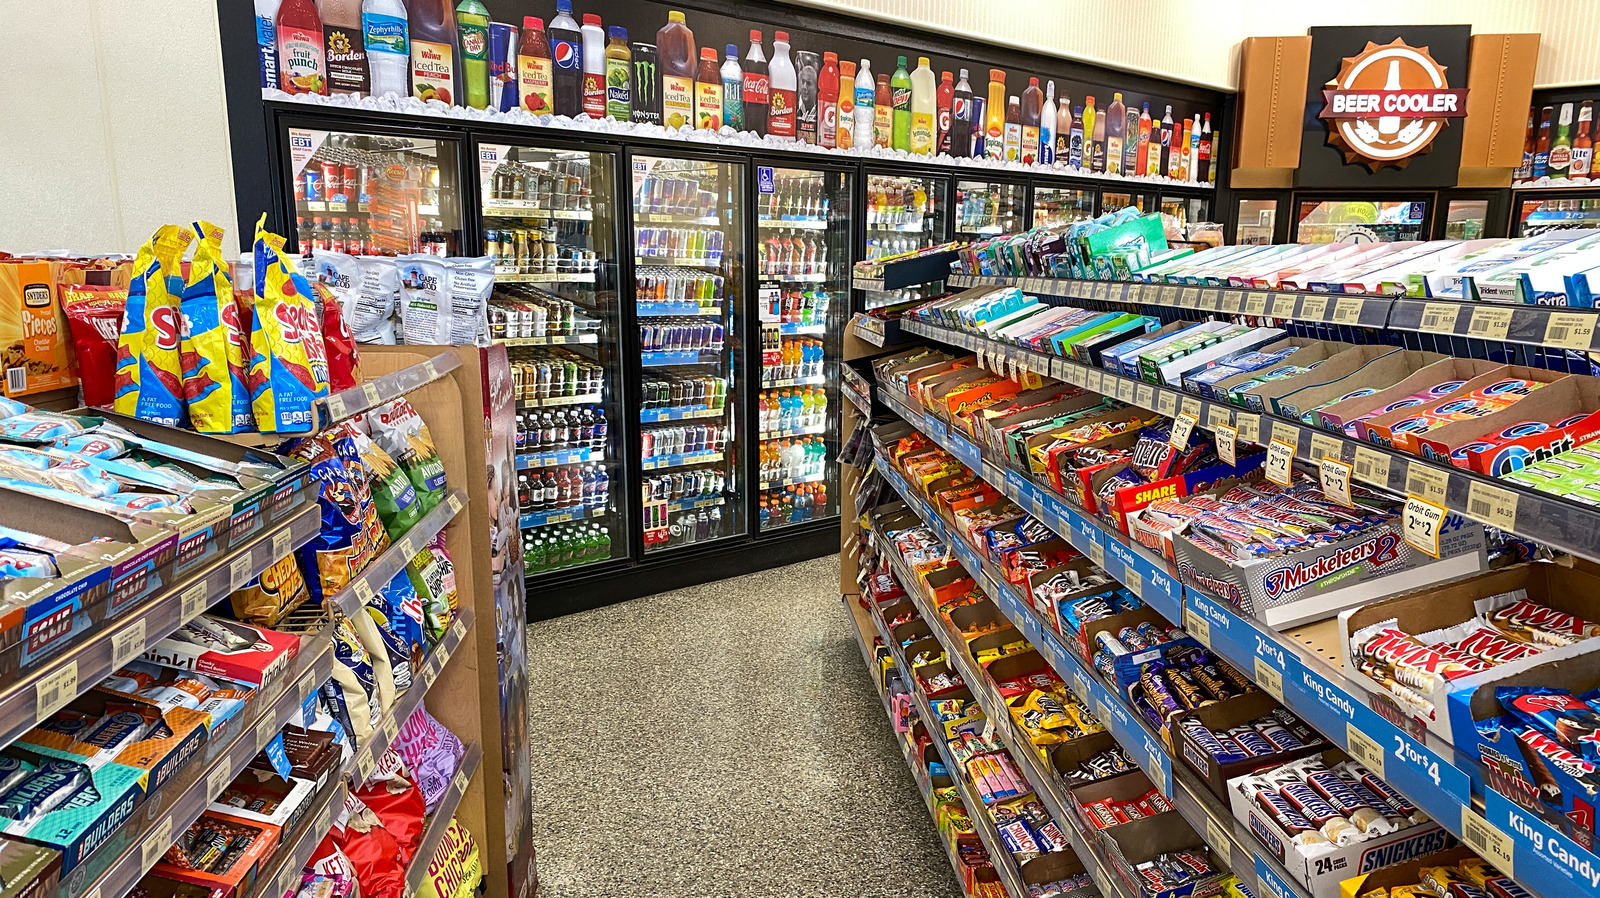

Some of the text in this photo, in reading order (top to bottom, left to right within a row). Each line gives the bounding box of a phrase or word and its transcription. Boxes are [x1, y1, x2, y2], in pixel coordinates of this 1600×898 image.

[293, 48, 311, 60] fruit
[326, 49, 365, 63] Borden
[421, 49, 442, 61] Wawa
[288, 57, 319, 71] punch
[414, 60, 450, 74] Iced Tea
[522, 71, 548, 81] Iced Tea
[584, 87, 605, 96] Borden
[724, 82, 740, 100] FIJI
[743, 77, 769, 94] Coca-Cola
[609, 89, 629, 101] Naked
[665, 92, 690, 102] Iced Tea
[770, 106, 794, 116] Borden
[1333, 94, 1458, 113] BEER COOLER
[292, 138, 312, 146] EBT
[1572, 150, 1588, 160] Lite
[633, 162, 646, 170] EBT
[333, 272, 350, 282] CAPE
[334, 280, 350, 289] COD
[418, 274, 438, 284] CAPE
[422, 282, 437, 291] COD
[1480, 286, 1498, 295] Trident
[26, 290, 48, 300] SNYDER'S
[65, 290, 94, 302] GRAB
[21, 310, 57, 338] Pieces
[1368, 428, 1393, 447] Orbit
[1579, 430, 1600, 442] STRAW
[1270, 443, 1291, 457] Orbit Gum
[1418, 442, 1451, 464] Orbit
[1490, 437, 1574, 478] Orbit
[1321, 462, 1347, 478] Orbit Gum
[1375, 467, 1387, 476] $1.59
[1135, 484, 1178, 505] SHARE
[1430, 486, 1444, 496] $1.59
[1051, 502, 1070, 520] King Candy
[1408, 502, 1440, 521] Orbit Gum
[1496, 508, 1513, 518] $0.35
[1440, 514, 1464, 535] 24
[1110, 544, 1134, 566] King Candy
[1264, 534, 1398, 599] 3 Musketeers 2
[1319, 568, 1358, 588] #THROWSHINE
[54, 582, 88, 602] CHOCOLATE CHIP
[1194, 598, 1230, 630] King Candy
[1495, 598, 1588, 636] TWIX
[1256, 635, 1264, 656] 2
[1366, 628, 1443, 674] TWIX
[64, 676, 76, 689] $1.99
[1302, 672, 1355, 719] King Candy
[1104, 693, 1128, 726] King Candy
[160, 732, 202, 779] BUILDERS
[1394, 735, 1407, 761] 2
[1406, 741, 1422, 764] for
[137, 756, 152, 766] 12
[1368, 752, 1382, 767] $2.19
[1313, 772, 1364, 809] SNICKERS
[1287, 784, 1334, 818] SNICKERS
[1328, 798, 1342, 811] WHITE
[1301, 807, 1317, 820] WHITE
[84, 793, 136, 854] BUILDERS
[1008, 824, 1036, 852] CRUNCH
[1042, 822, 1068, 848] CRUNCH
[1250, 816, 1281, 855] SNICKERS
[1364, 828, 1447, 874] SNICKERS
[1492, 844, 1511, 862] $2.19
[1508, 810, 1600, 888] King Candy
[1314, 860, 1332, 876] 24
[1334, 862, 1348, 870] PACKS
